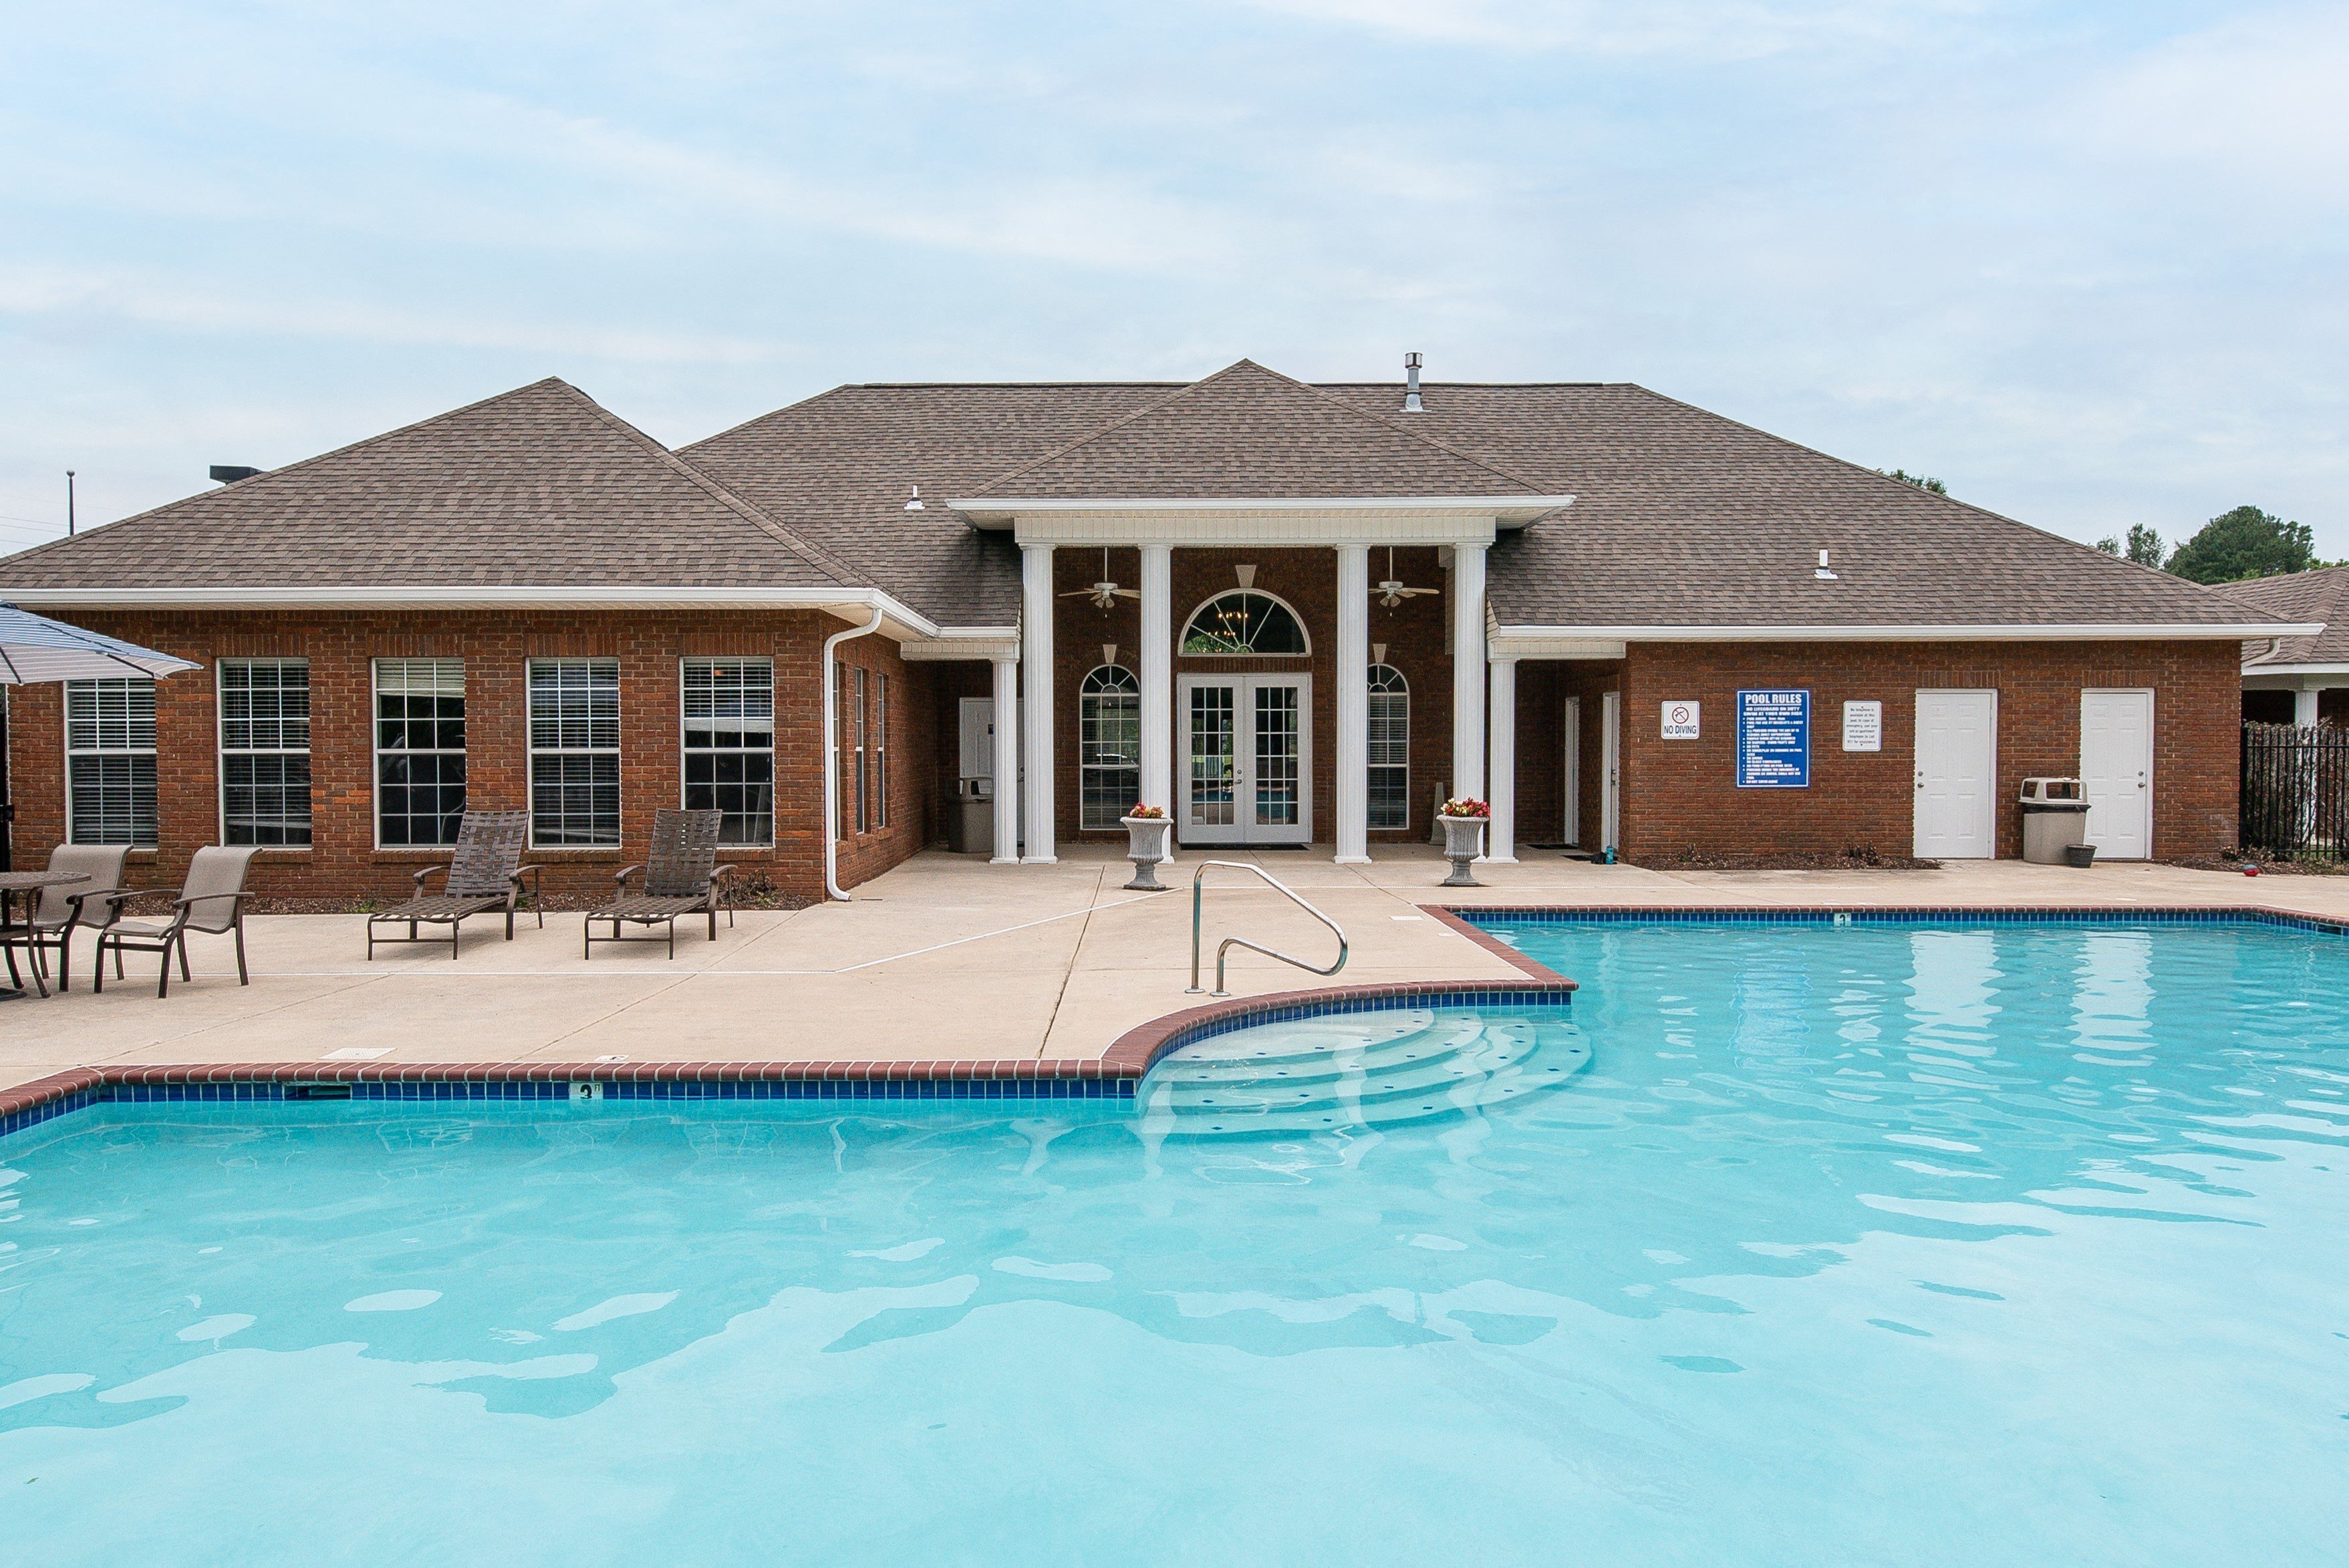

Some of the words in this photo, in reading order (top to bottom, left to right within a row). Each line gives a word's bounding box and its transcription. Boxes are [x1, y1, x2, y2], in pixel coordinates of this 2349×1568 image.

[1746, 694, 1770, 703] POOL
[1772, 694, 1802, 703] RULES
[1664, 725, 1673, 734] NO
[1675, 725, 1697, 734] DIVING
[580, 1084, 593, 1099] 3
